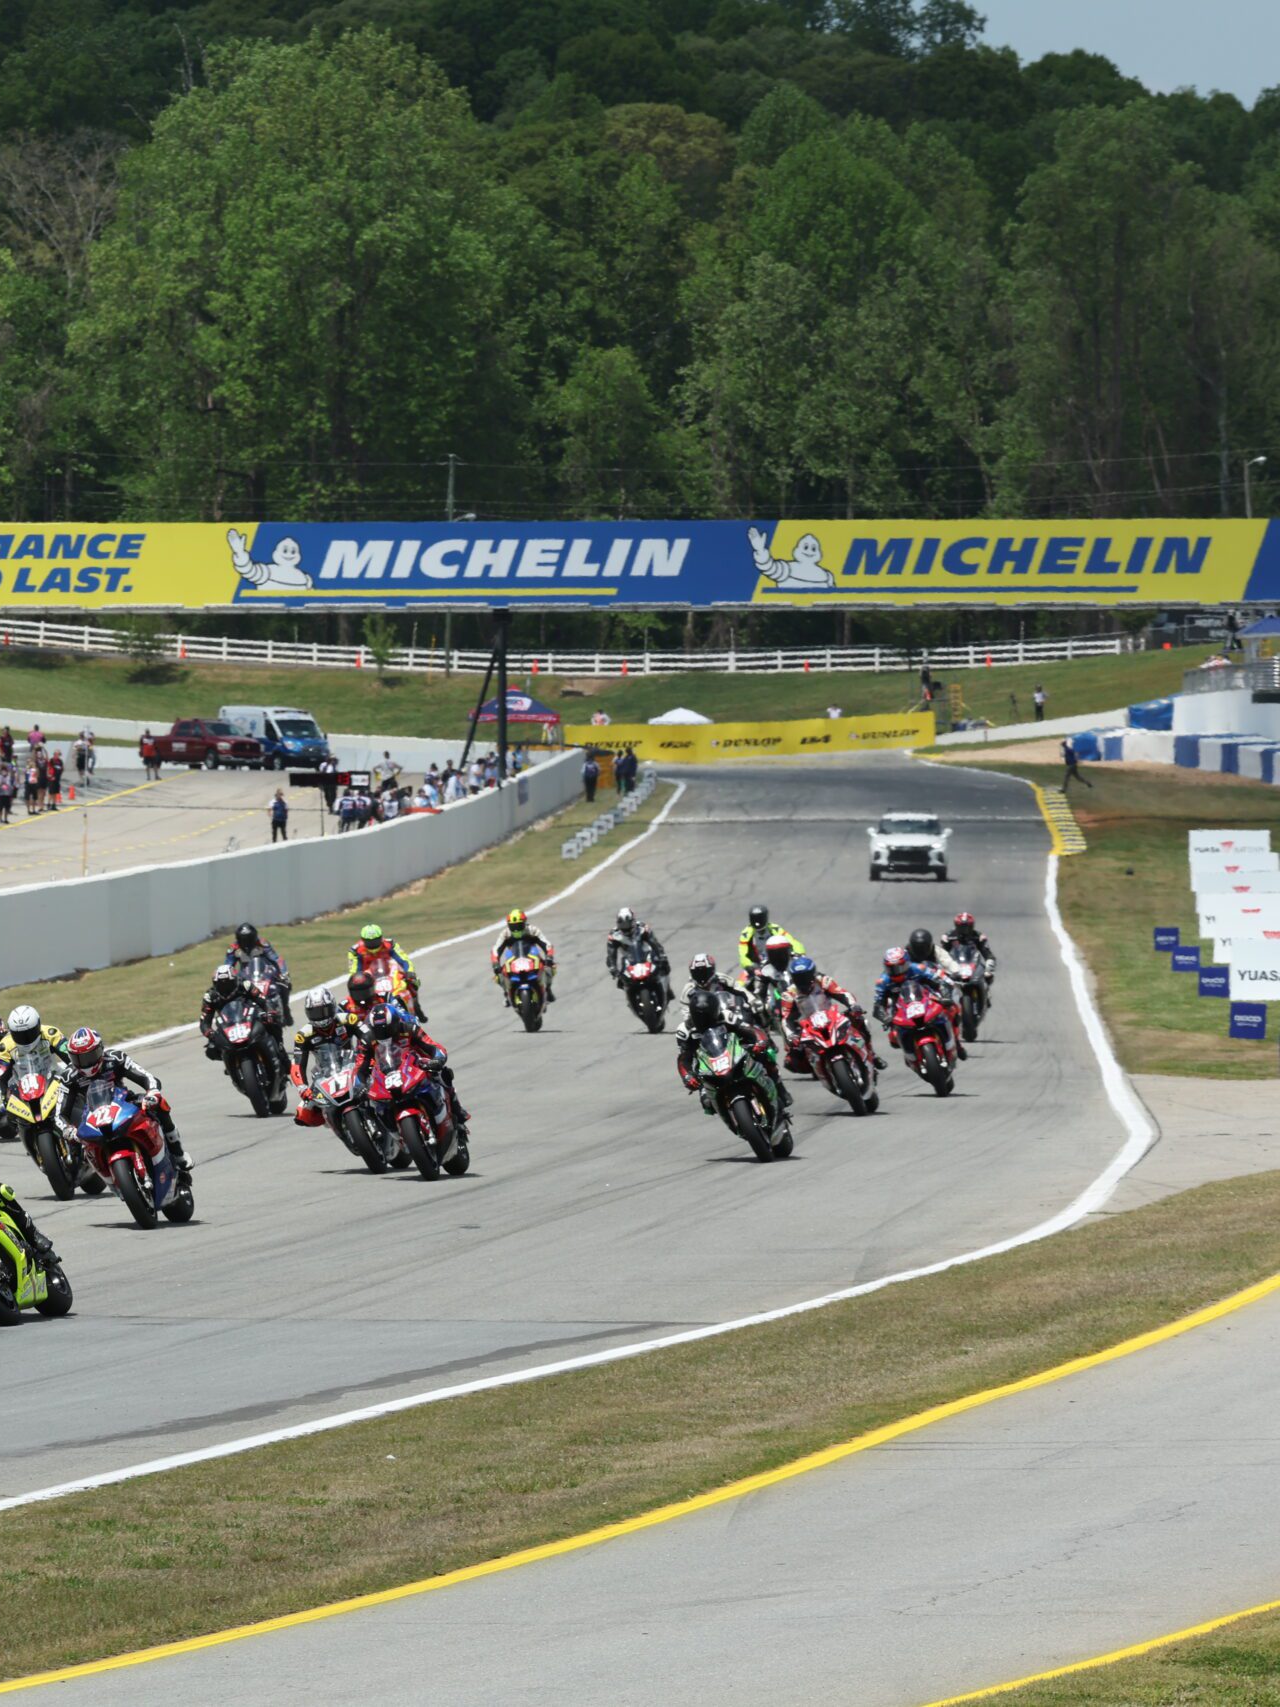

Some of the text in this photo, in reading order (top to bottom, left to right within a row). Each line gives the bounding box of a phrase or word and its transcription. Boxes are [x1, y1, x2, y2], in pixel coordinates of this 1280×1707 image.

[319, 538, 690, 579] MICHELIN
[842, 536, 1212, 576] MICHELIN
[12, 567, 134, 593] LAST.
[723, 737, 782, 747] DUNLOP
[862, 729, 919, 740] DUNLOP
[1238, 970, 1280, 981] YUAS
